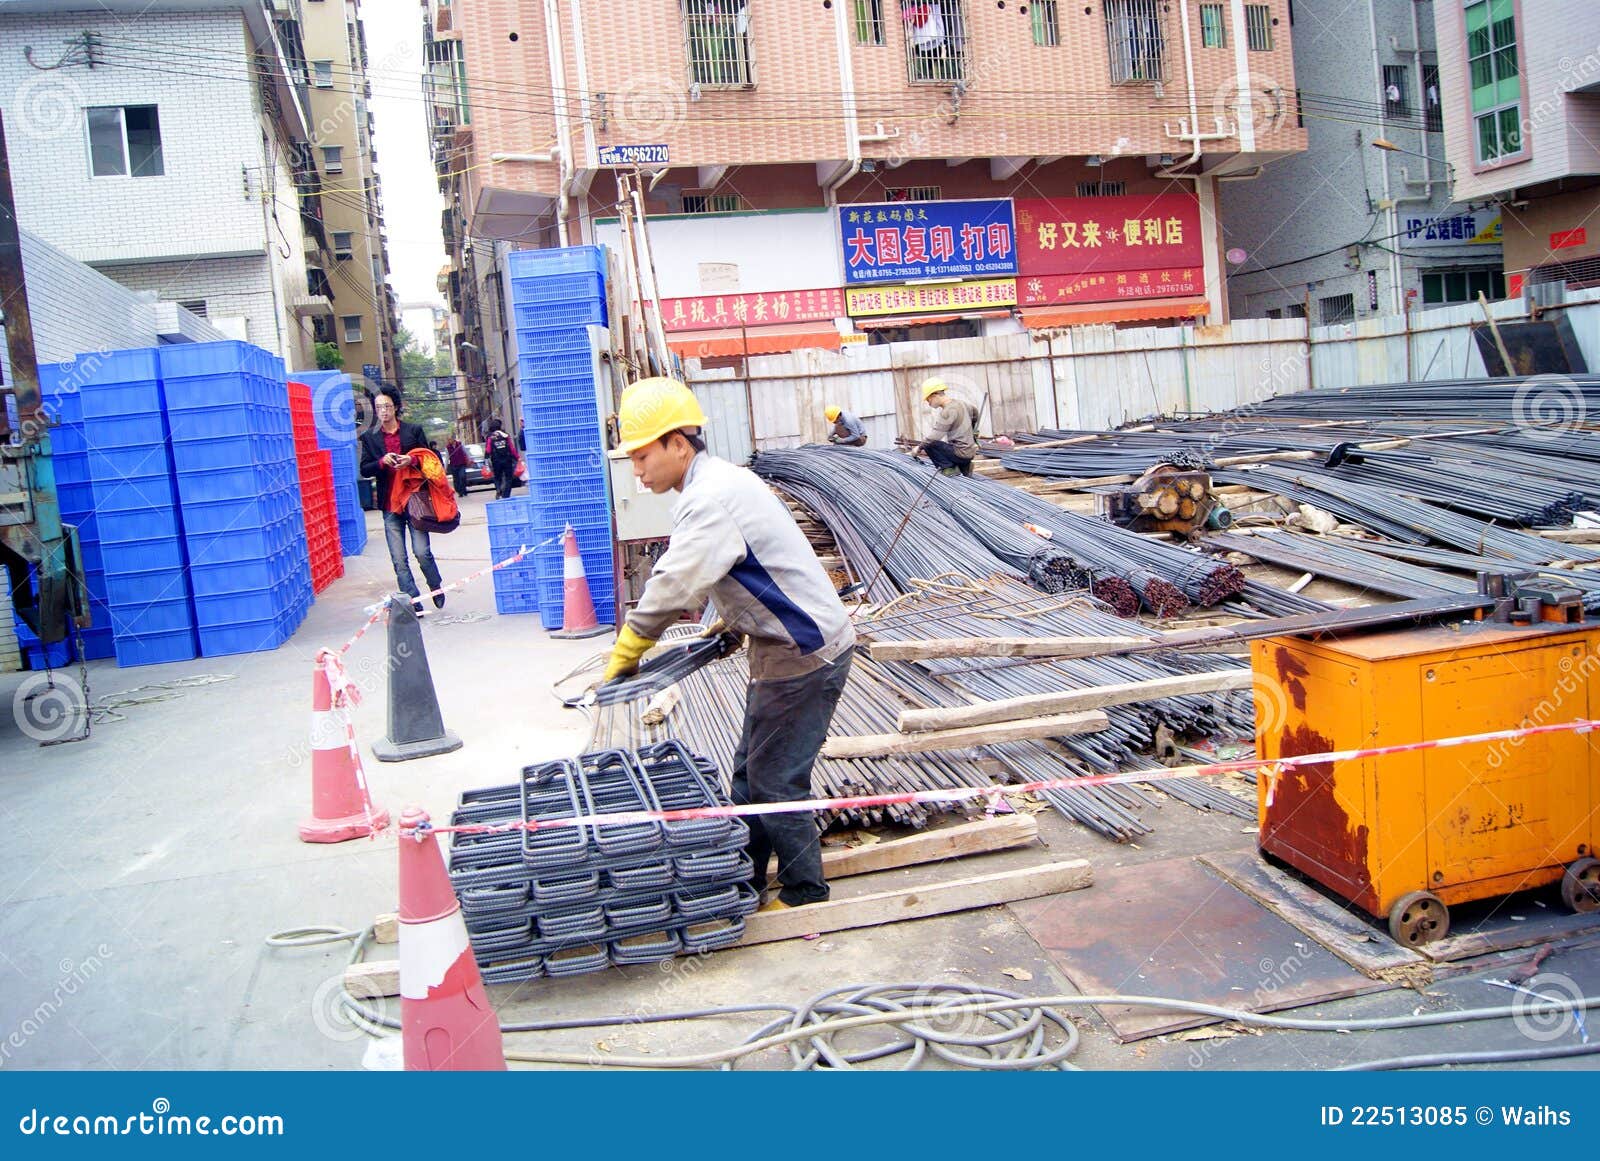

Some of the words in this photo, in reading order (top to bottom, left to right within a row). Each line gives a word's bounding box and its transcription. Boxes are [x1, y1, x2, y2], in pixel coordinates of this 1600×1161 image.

[848, 225, 955, 268] 大图复印
[960, 222, 1011, 261] 打印
[1038, 220, 1102, 250] 好又来
[1123, 216, 1183, 247] 便利店
[662, 294, 790, 328] 具玩具特卖场
